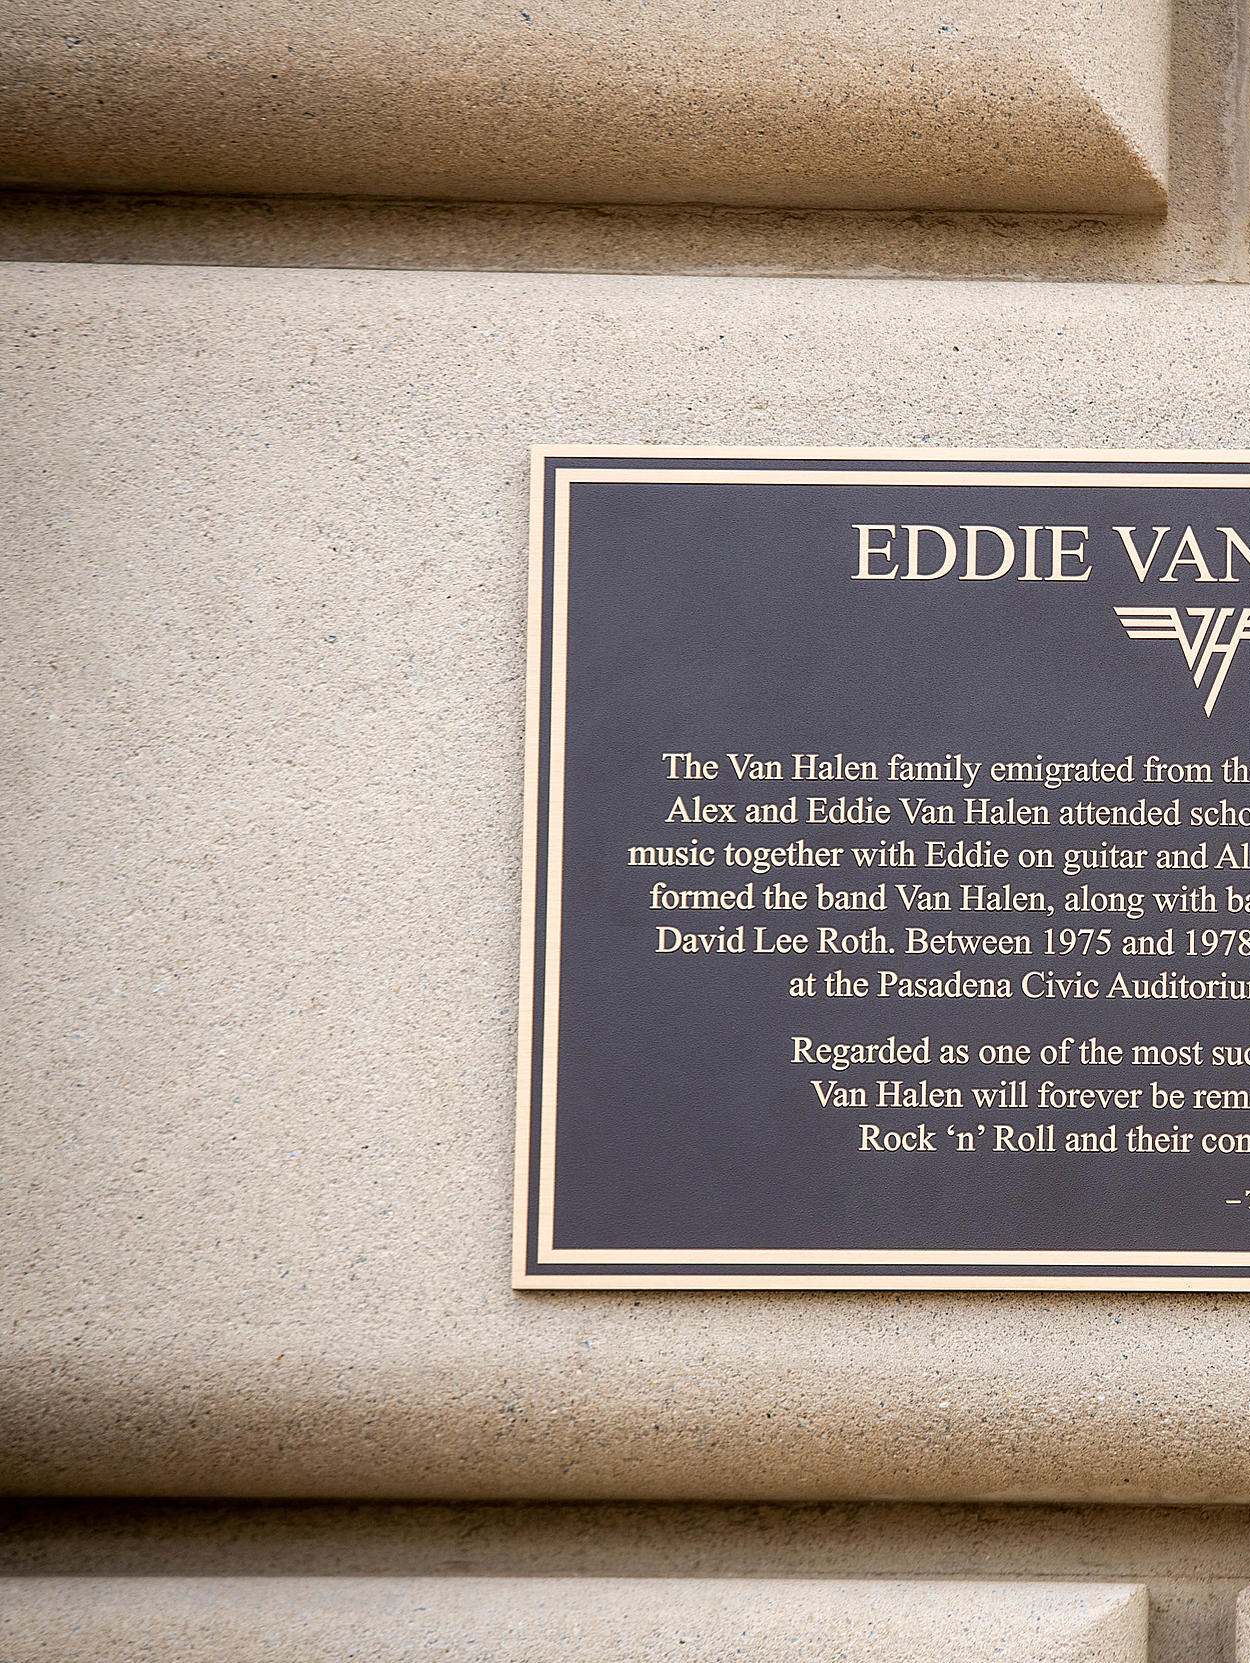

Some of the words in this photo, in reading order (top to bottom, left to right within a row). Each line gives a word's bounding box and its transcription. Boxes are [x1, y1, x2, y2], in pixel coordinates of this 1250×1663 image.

[850, 524, 1093, 581] EDDIE
[661, 752, 719, 780] The
[726, 753, 784, 780] Van
[791, 753, 879, 781] Halen
[887, 753, 983, 789] family
[990, 754, 1135, 789] emigrated
[1142, 755, 1214, 783] from
[664, 795, 737, 823] Alex
[745, 796, 799, 824] and
[805, 796, 891, 824] Eddie
[898, 797, 956, 824] Van
[963, 797, 1051, 825] Halen
[1059, 798, 1182, 826] attended
[627, 838, 715, 867] music
[723, 839, 845, 874] together
[850, 839, 917, 867] with
[924, 840, 1009, 868] Eddie
[1018, 849, 1055, 868] on
[1062, 841, 1149, 876] guitar
[1156, 841, 1209, 869] and
[649, 881, 756, 910] formed
[762, 882, 808, 911] the
[815, 882, 888, 911] band
[894, 884, 952, 911] Van
[959, 883, 1055, 917] Halen,
[1064, 884, 1145, 920] along
[1152, 885, 1218, 913] with
[655, 925, 746, 954] David
[752, 926, 809, 954] Lee
[816, 926, 895, 954] Roth.
[904, 927, 1033, 955] Between
[1044, 928, 1112, 955] 1975
[1122, 928, 1176, 956] and
[789, 972, 817, 997] at
[823, 969, 869, 998] the
[876, 970, 1014, 998] Pasadena
[1021, 970, 1100, 999] Civic
[790, 1035, 932, 1071] Regarded
[939, 1044, 970, 1064] as
[978, 1044, 1031, 1065] one
[1040, 1037, 1075, 1065] of
[1078, 1037, 1123, 1065] the
[1131, 1041, 1204, 1066] most
[810, 1080, 869, 1108] Van
[875, 1079, 964, 1108] Halen
[971, 1080, 1029, 1108] will
[1037, 1080, 1143, 1109] forever
[1149, 1081, 1185, 1109] be
[858, 1123, 937, 1152] Rock
[992, 1124, 1057, 1152] Roll
[1065, 1124, 1119, 1153] and
[1125, 1124, 1194, 1153] their
